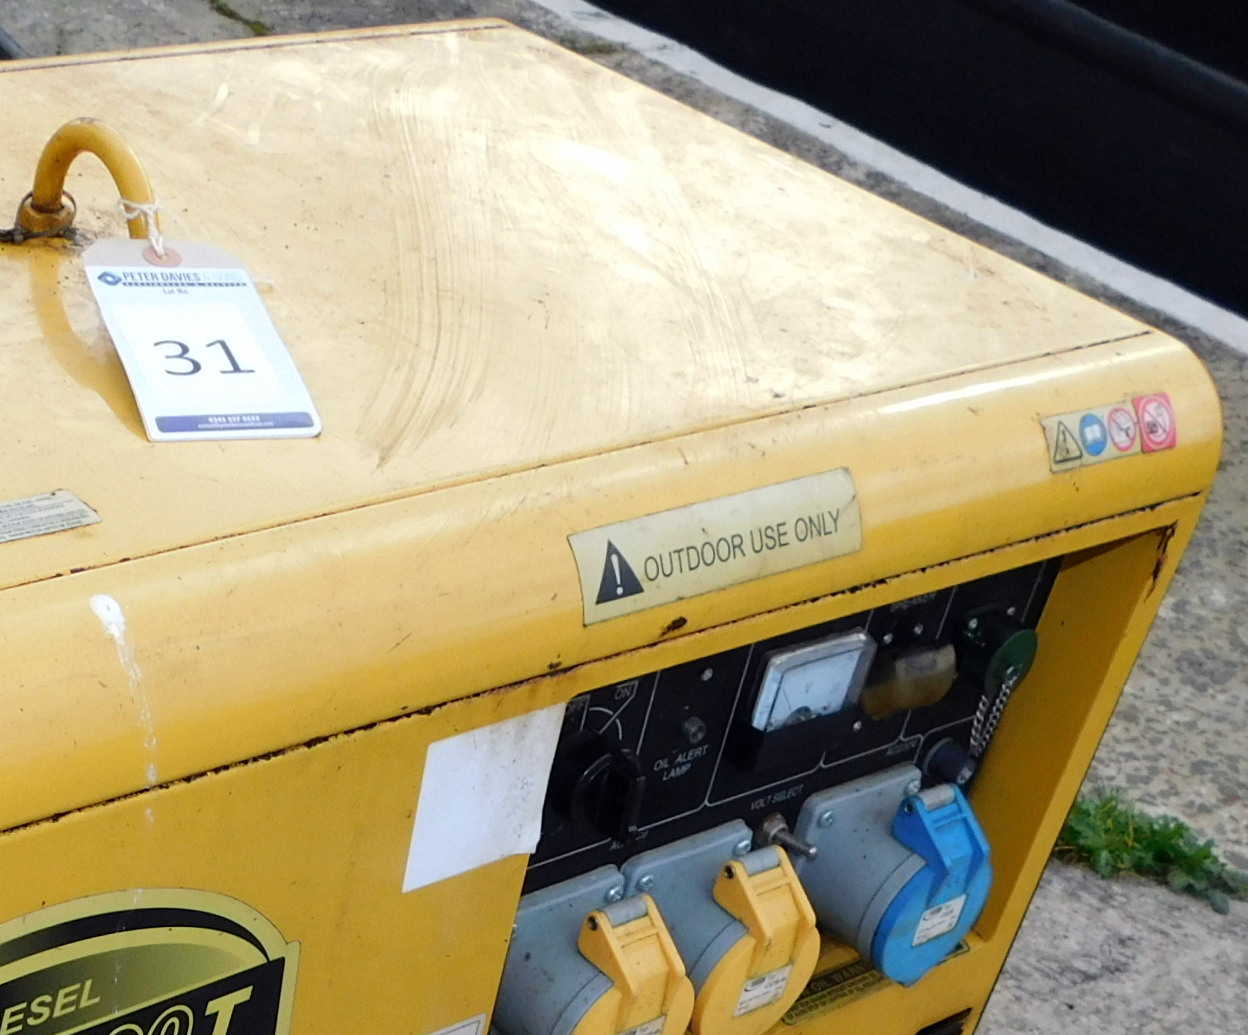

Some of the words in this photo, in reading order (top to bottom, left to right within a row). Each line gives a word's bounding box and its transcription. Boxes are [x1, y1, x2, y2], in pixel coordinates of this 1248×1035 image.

[122, 271, 160, 282] PETER
[161, 271, 202, 282] DAVIES
[153, 339, 256, 376] 31
[643, 533, 746, 582] OUTDOOR
[750, 522, 790, 554] USE
[794, 508, 841, 543] ONLY
[654, 757, 671, 772] OIL
[675, 745, 709, 765] ALERT
[662, 764, 691, 781] LAMP
